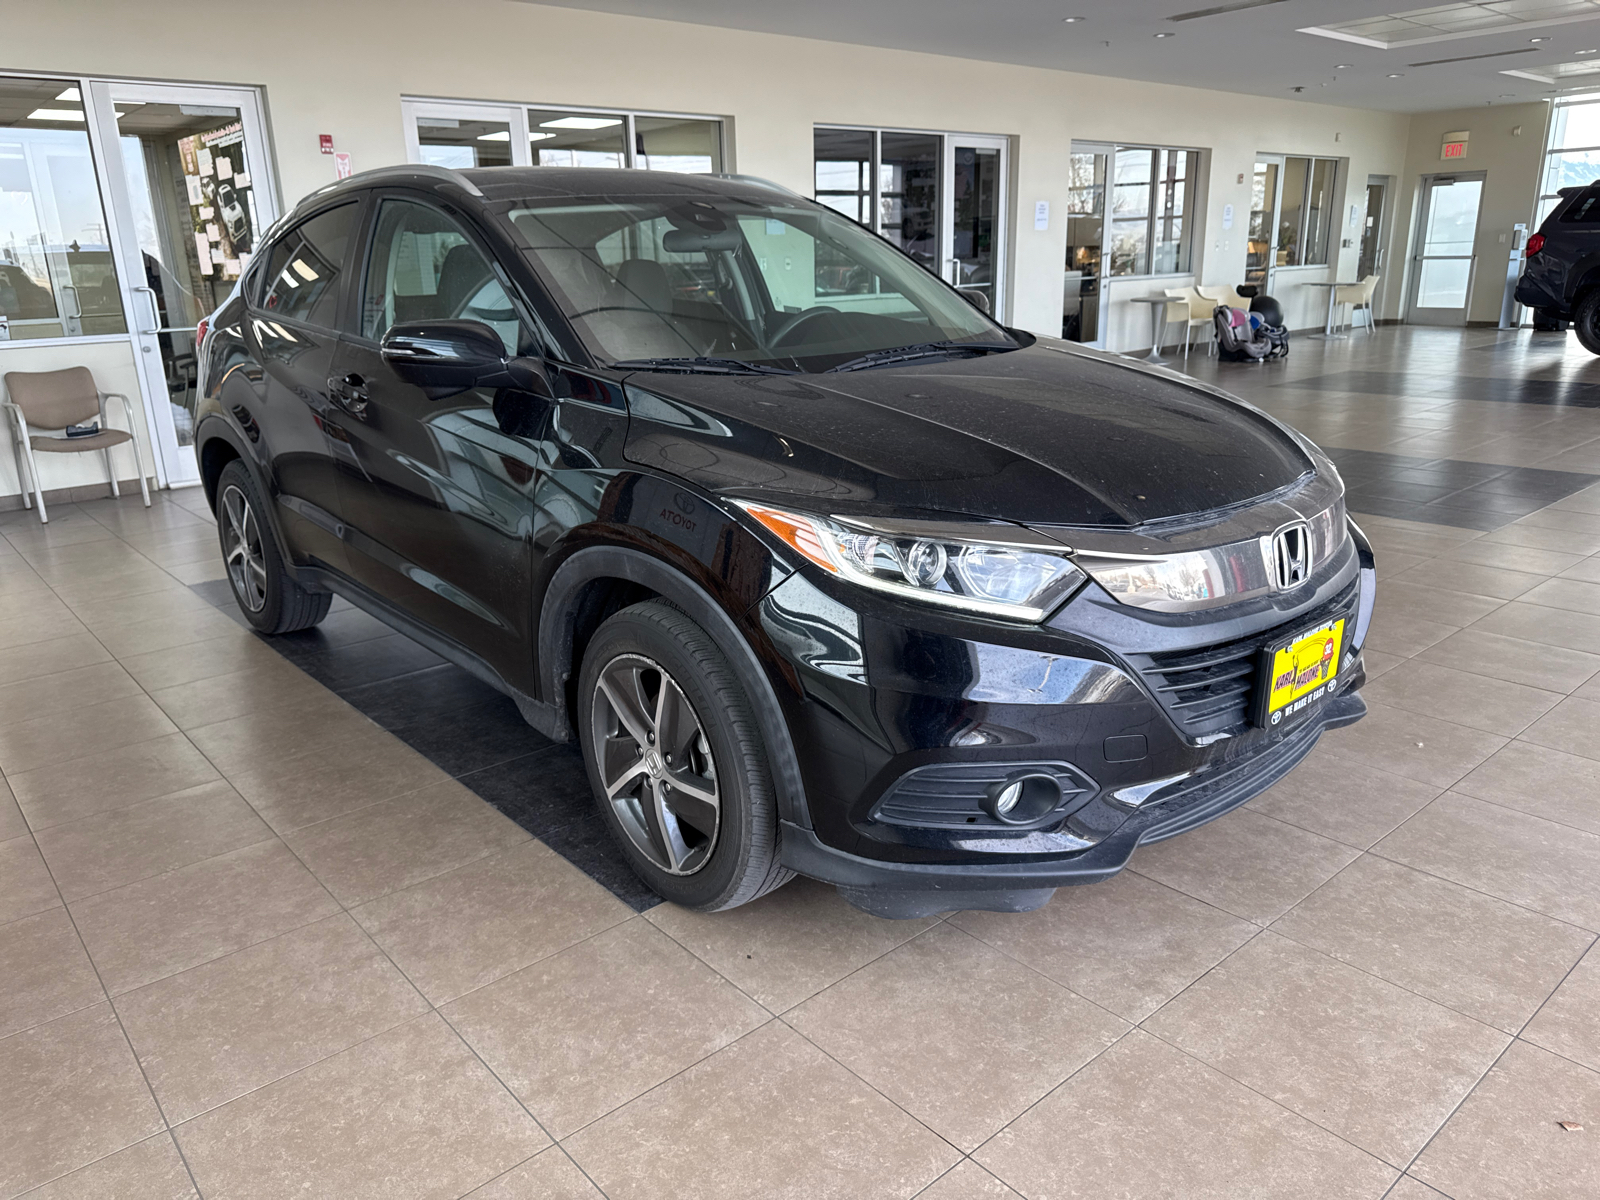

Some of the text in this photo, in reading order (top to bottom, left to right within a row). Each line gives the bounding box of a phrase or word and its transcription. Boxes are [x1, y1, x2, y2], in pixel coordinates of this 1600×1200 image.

[1445, 143, 1463, 157] EXIT
[1324, 642, 1333, 656] 32
[1273, 669, 1294, 694] KARL
[1294, 664, 1321, 691] MALONE
[1285, 686, 1325, 716] WE MAKE IT EASY
